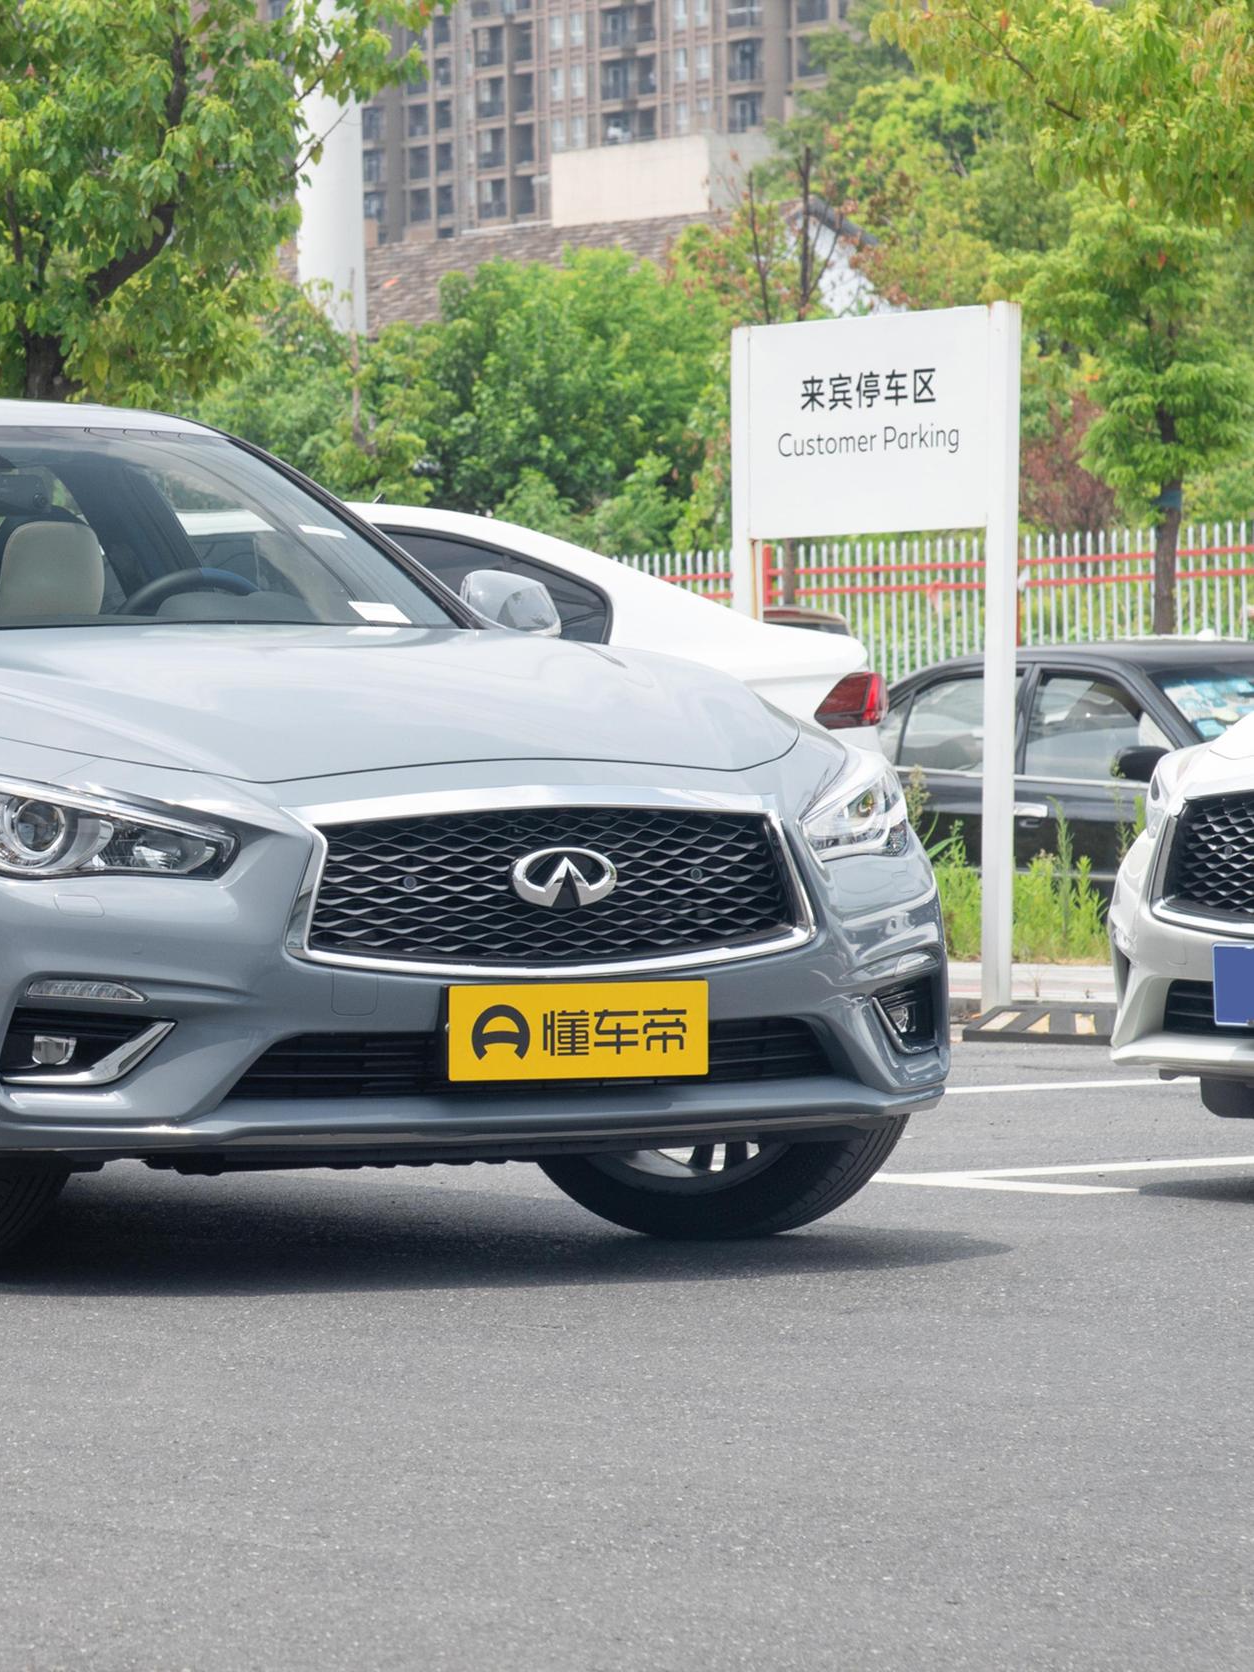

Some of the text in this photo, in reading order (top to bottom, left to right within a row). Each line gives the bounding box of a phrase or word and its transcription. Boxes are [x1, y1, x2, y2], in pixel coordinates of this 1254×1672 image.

[800, 367, 936, 411] 来宾停车区
[777, 422, 960, 458] Customer Parking
[542, 1007, 688, 1057] 懂车帝
